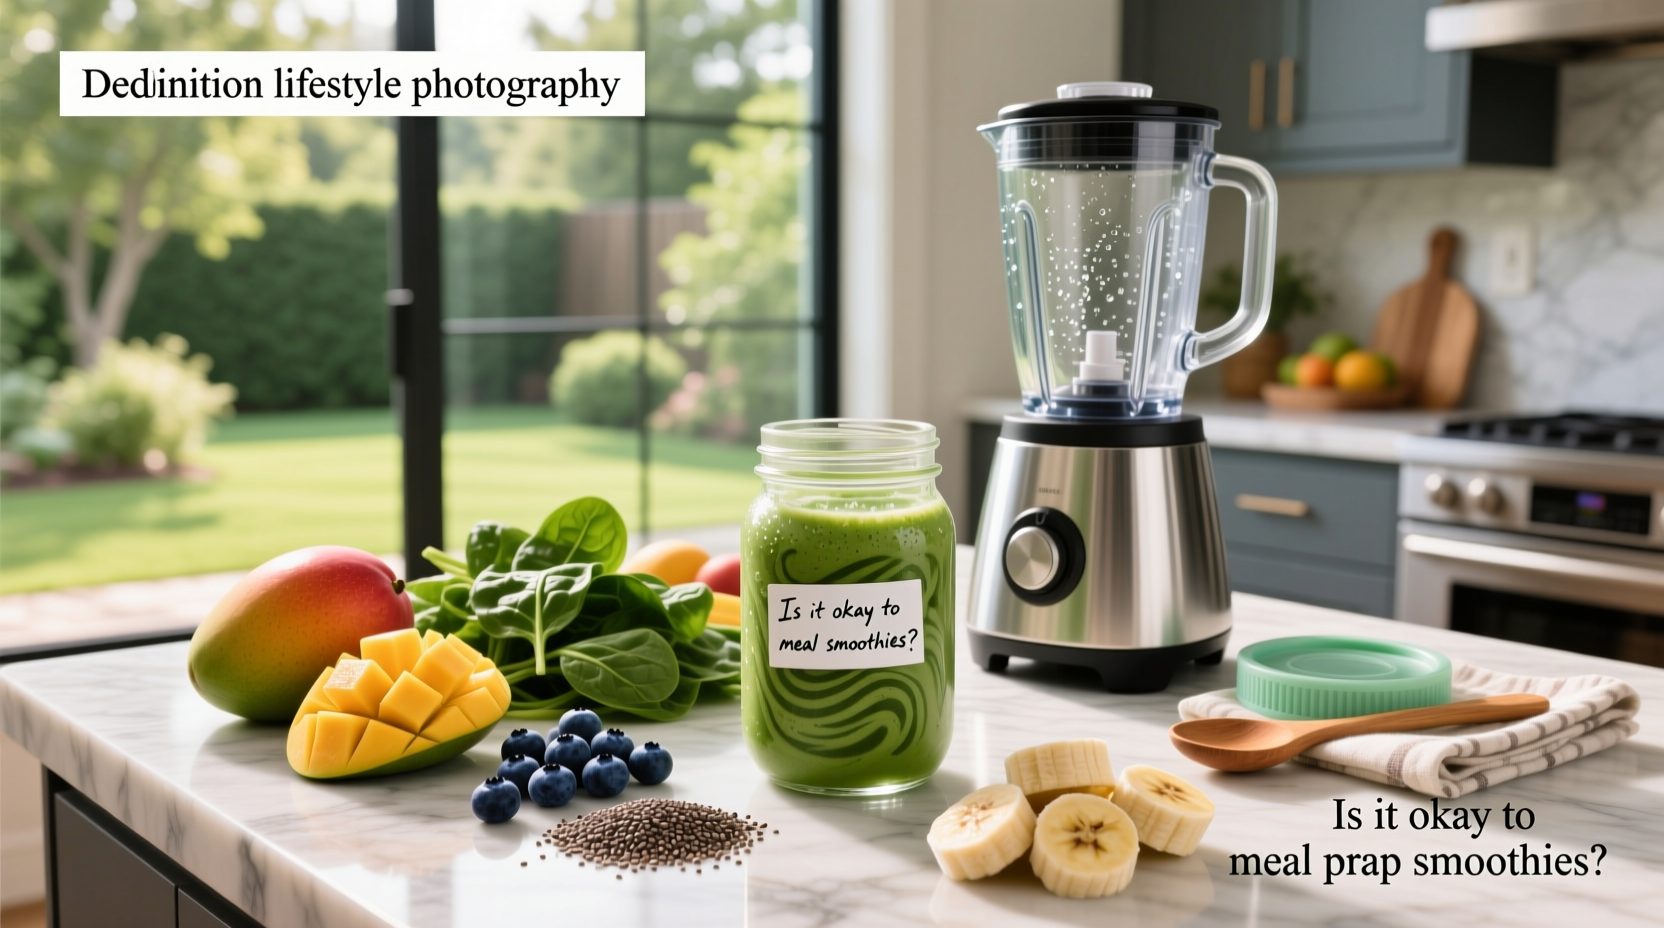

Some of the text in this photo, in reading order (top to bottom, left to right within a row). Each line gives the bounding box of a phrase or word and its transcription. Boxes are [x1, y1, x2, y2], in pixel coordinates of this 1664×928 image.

[778, 597, 901, 627] Is it okay to
[779, 628, 919, 652] meal smoothies?
